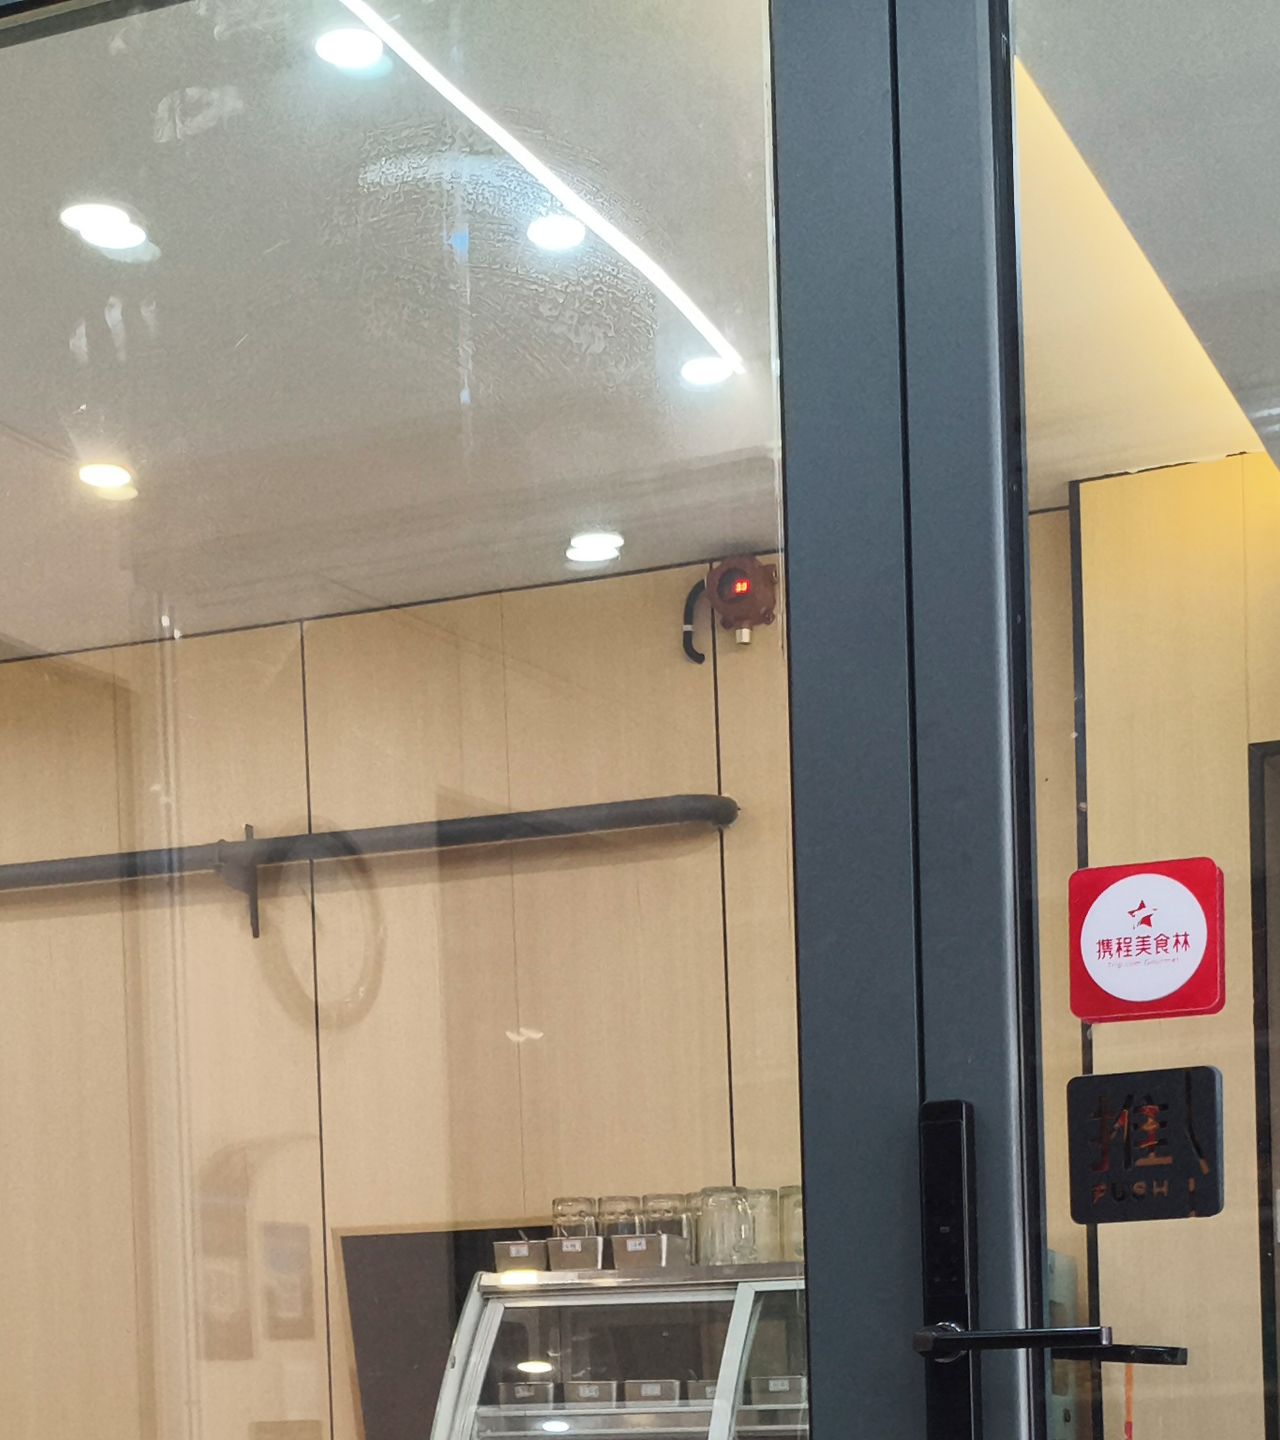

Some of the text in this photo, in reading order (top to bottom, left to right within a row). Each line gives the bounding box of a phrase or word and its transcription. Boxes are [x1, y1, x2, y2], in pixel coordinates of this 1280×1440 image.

[1096, 931, 1190, 960] 携程美食林
[1089, 1094, 1173, 1173] 推
